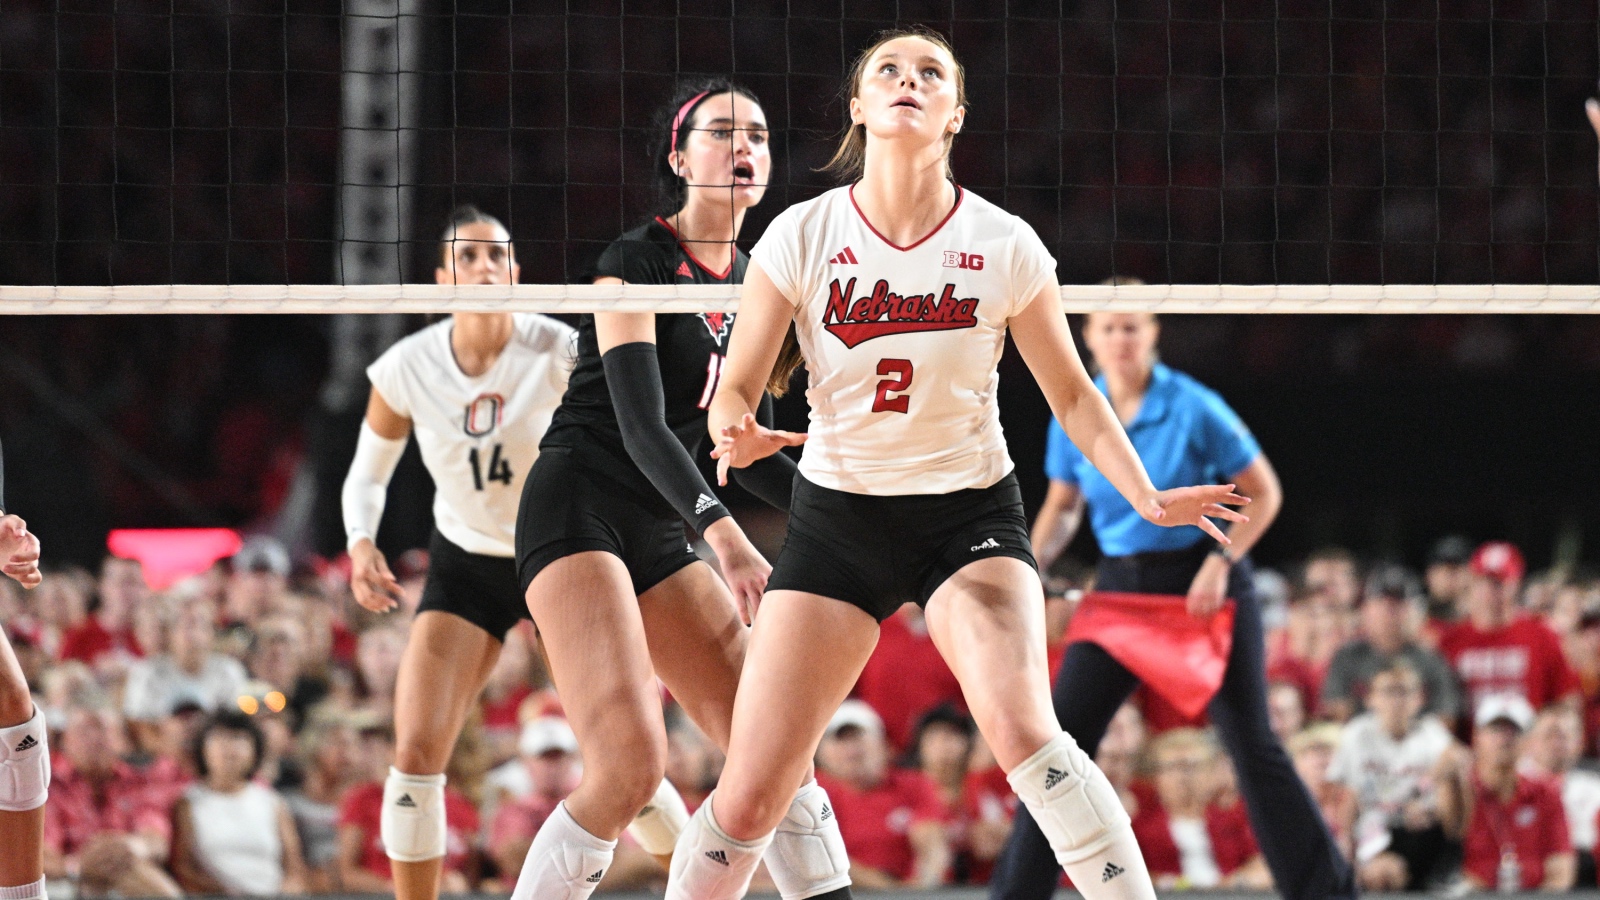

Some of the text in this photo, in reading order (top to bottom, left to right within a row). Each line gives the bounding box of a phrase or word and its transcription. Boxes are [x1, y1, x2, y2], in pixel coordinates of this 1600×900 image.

[822, 277, 980, 325] Nebraska
[871, 358, 914, 415] 2
[468, 443, 514, 491] 14
[695, 499, 719, 515] adidas
[15, 740, 39, 752] adidas
[1045, 771, 1069, 790] adidas
